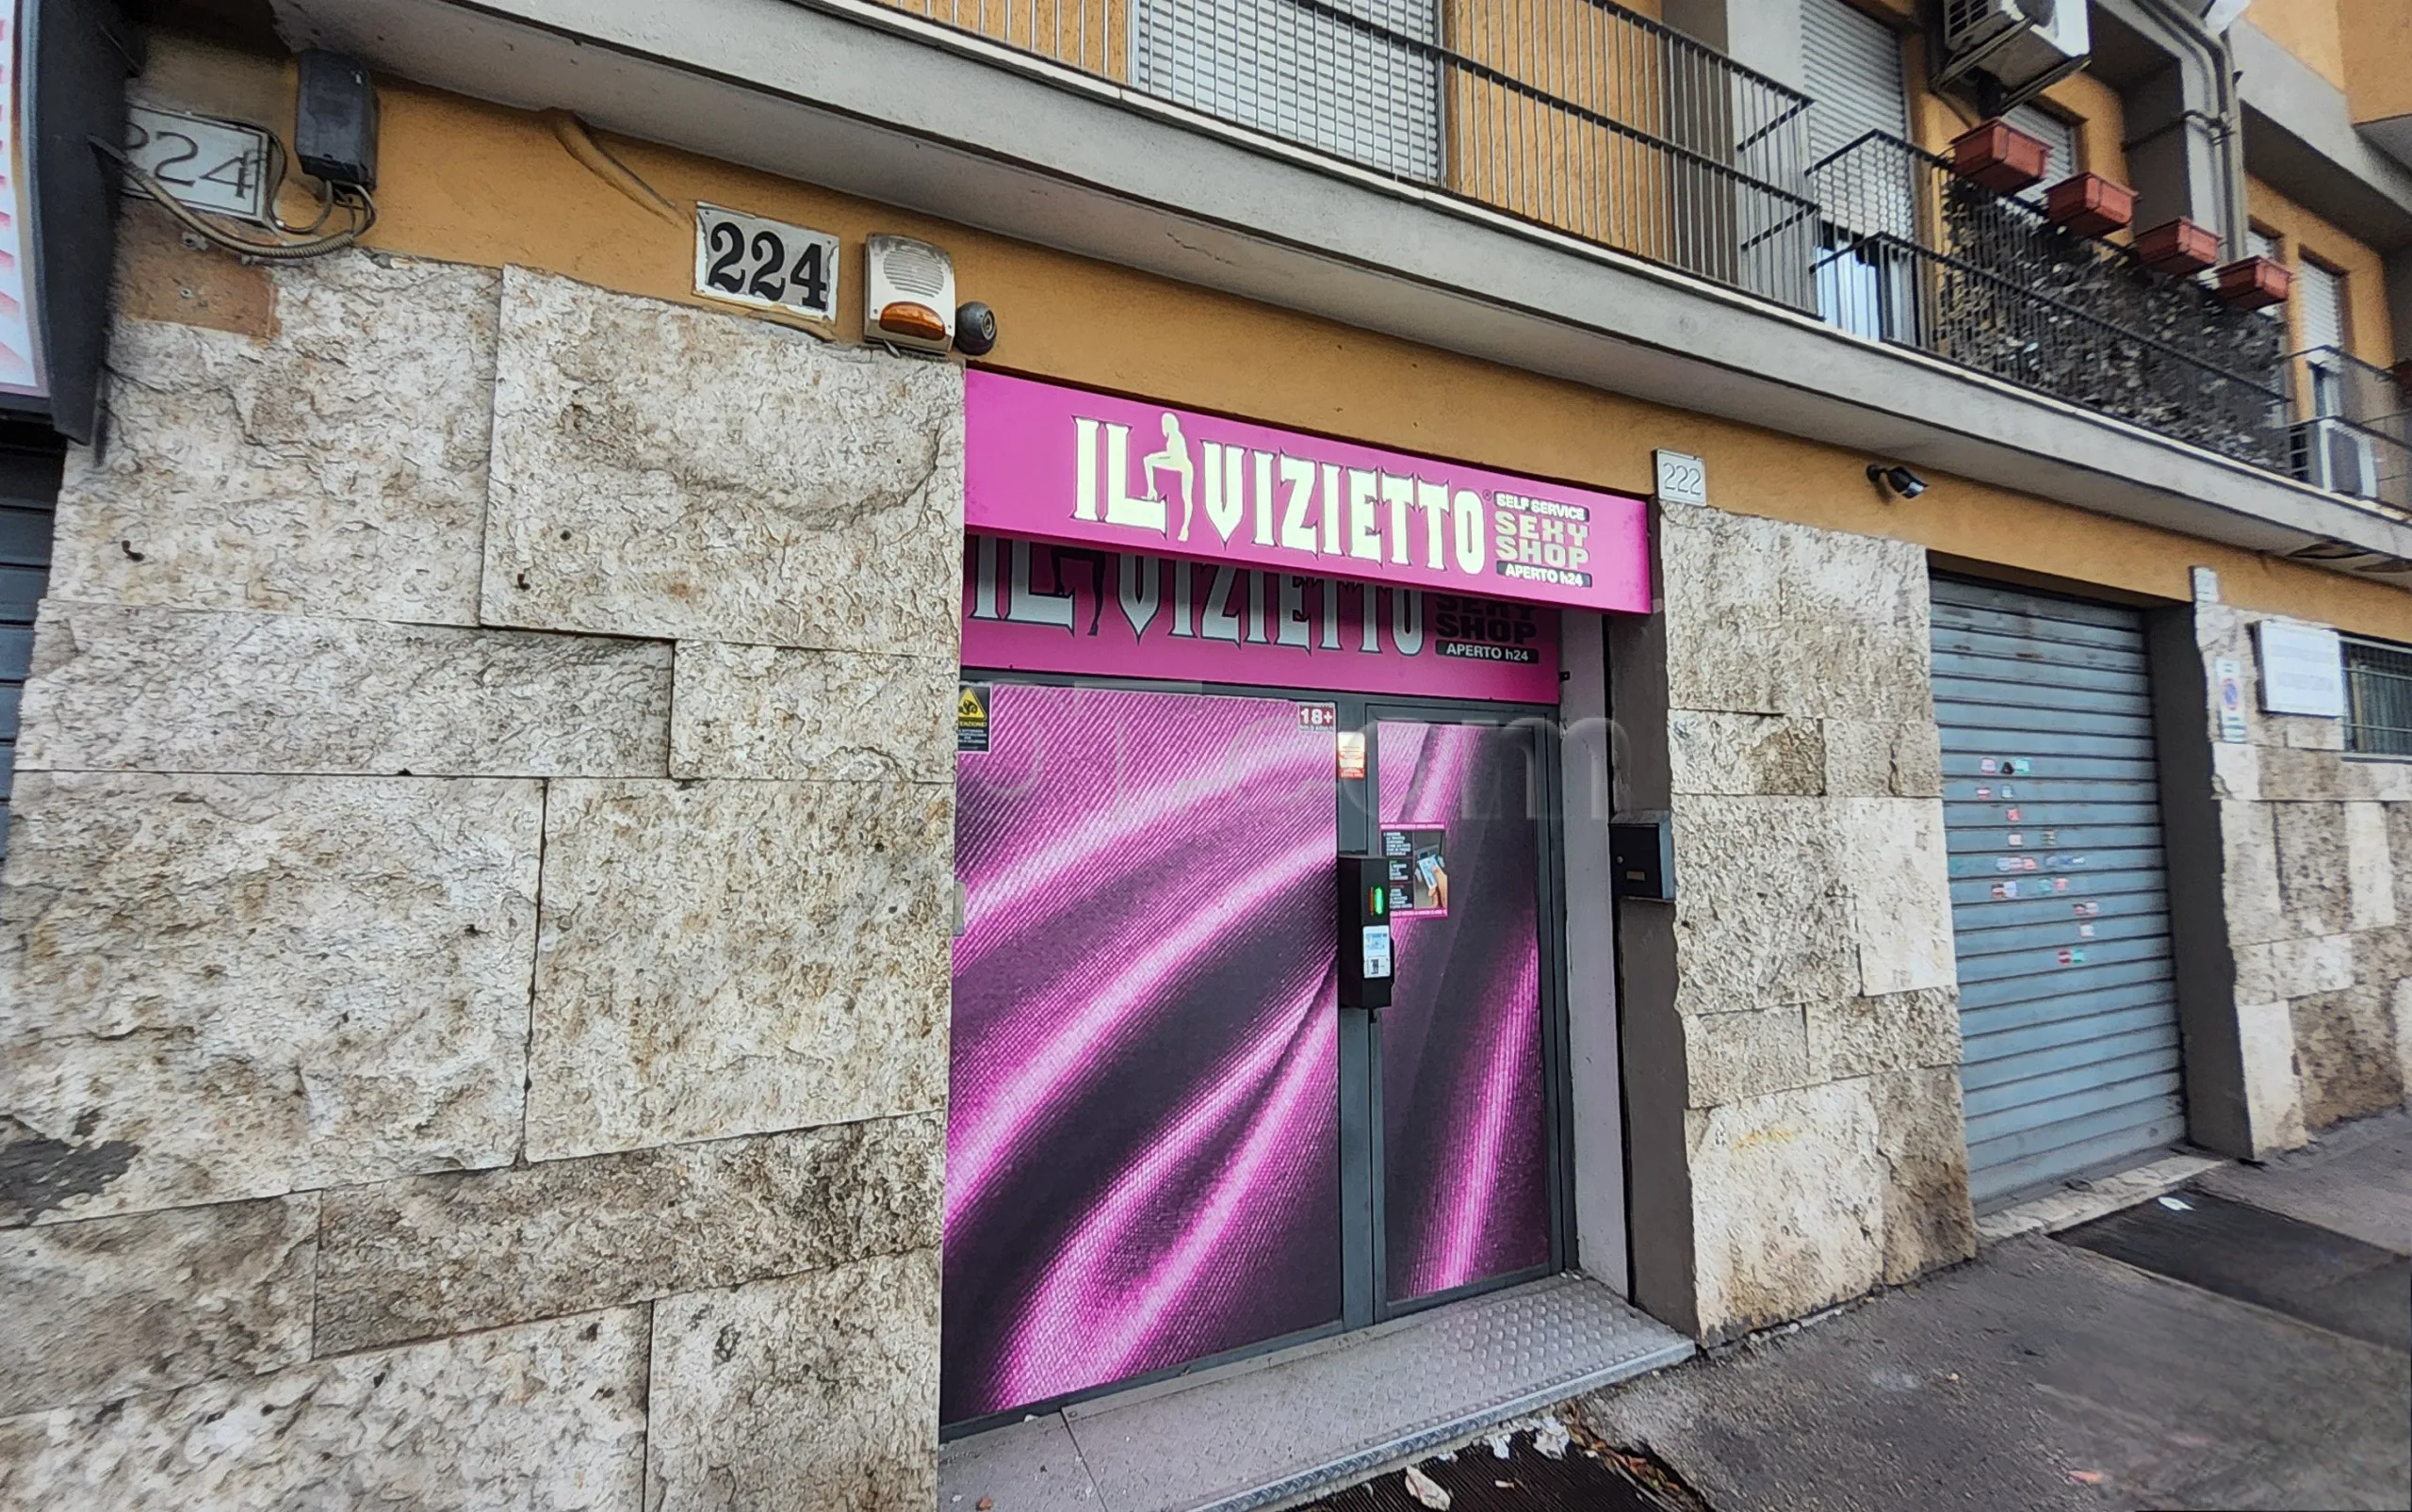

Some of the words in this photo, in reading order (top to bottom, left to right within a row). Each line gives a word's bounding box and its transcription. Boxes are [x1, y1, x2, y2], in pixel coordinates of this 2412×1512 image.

[706, 221, 827, 310] 224
[1070, 415, 1168, 540] IL
[1199, 438, 1487, 576] VIZIETTO
[1662, 462, 1702, 496] 222
[1495, 493, 1529, 512] SELF
[1530, 498, 1586, 521] SERVICE
[1494, 510, 1589, 547] SEXY
[1495, 535, 1589, 571] SHOP
[969, 534, 1075, 638] IL
[1505, 563, 1558, 584] APERTO
[1559, 571, 1584, 587] h24
[1435, 612, 1538, 644] SHOP
[1446, 642, 1502, 659] APERTO
[1505, 648, 1529, 661] h24
[1300, 707, 1333, 724] 18+
